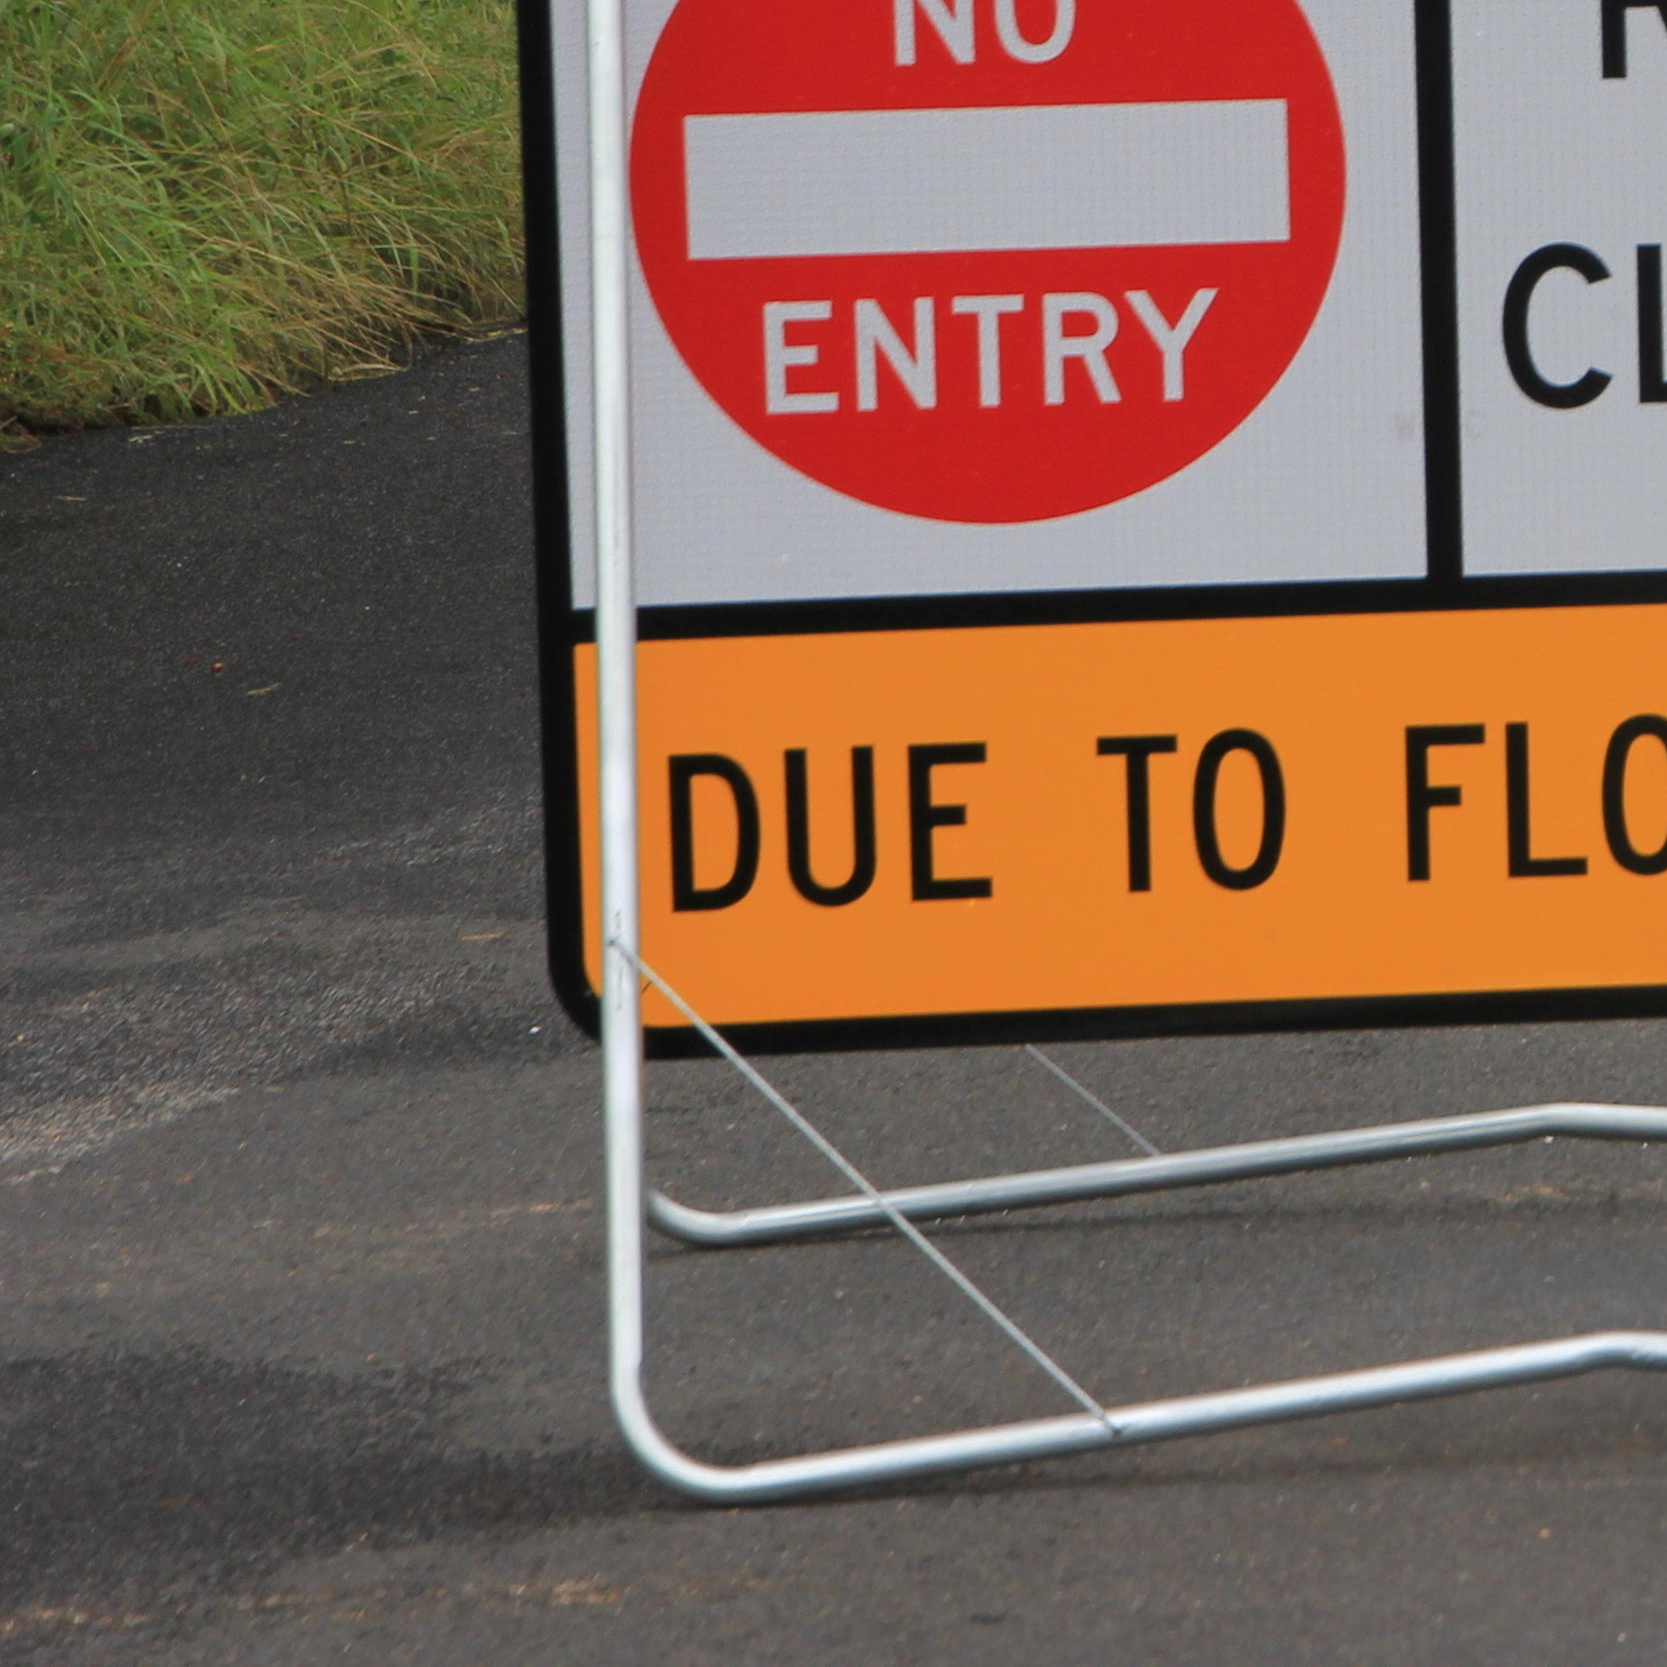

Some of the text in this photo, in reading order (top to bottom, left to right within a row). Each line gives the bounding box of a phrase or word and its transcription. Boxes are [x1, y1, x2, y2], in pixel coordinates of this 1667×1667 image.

[762, 287, 1218, 416] ENTRY
[667, 741, 994, 913] DUE
[1096, 727, 1287, 893] TO
